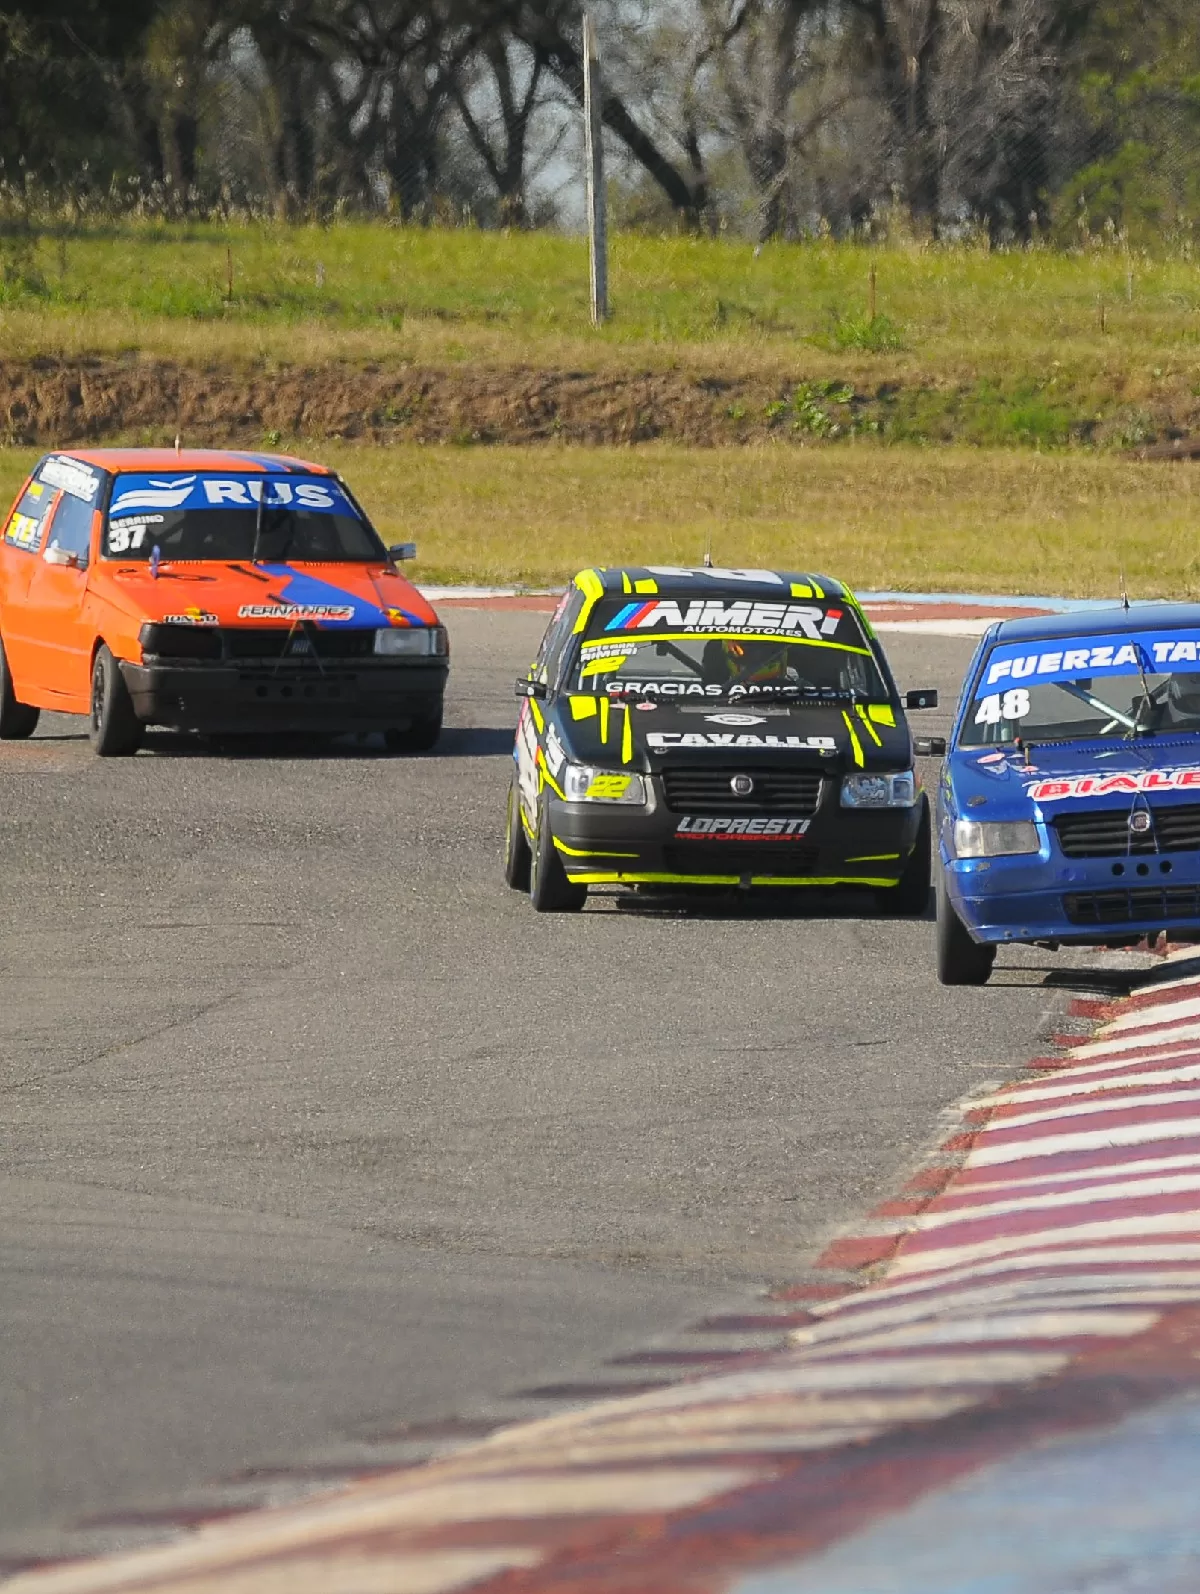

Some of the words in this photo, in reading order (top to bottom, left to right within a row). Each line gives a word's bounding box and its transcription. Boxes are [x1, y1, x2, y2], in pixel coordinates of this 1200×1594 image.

[203, 480, 335, 508] RUS
[109, 525, 147, 553] 37
[683, 625, 802, 638] AUTOMOTORES
[987, 645, 1138, 685] FUERZA
[605, 682, 723, 695] GRACIAS
[975, 688, 1030, 725] 48
[646, 733, 837, 749] CAVALLO
[585, 775, 632, 798] 22
[677, 816, 811, 834] LOPRESTI
